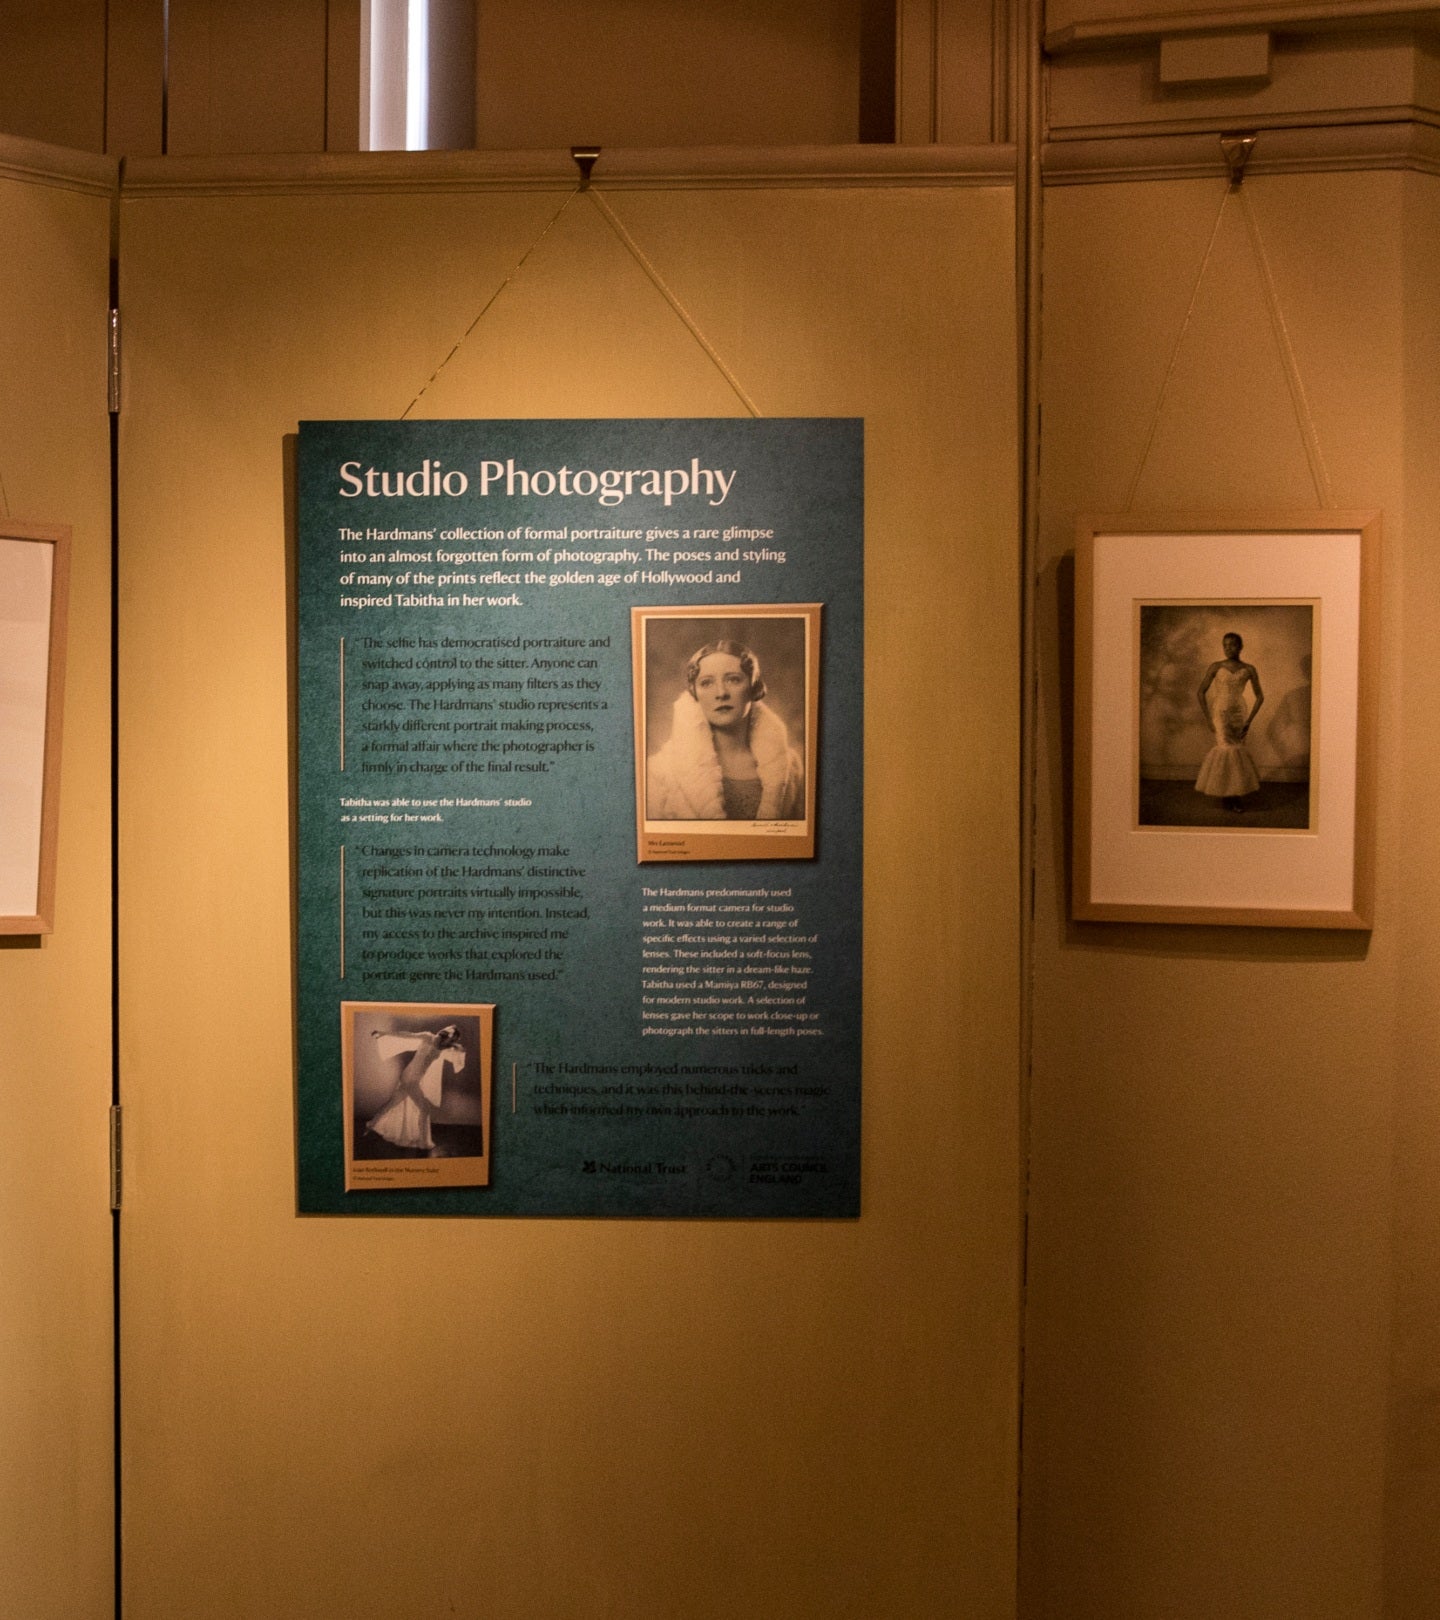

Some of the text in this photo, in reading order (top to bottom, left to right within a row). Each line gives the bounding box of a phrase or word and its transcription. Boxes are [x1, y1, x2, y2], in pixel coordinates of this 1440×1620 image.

[339, 458, 736, 506] Studio Photography
[338, 528, 363, 540] The
[440, 527, 504, 540] collection
[507, 527, 522, 539] of
[525, 527, 567, 539] formal
[571, 527, 642, 542] portraiture
[646, 527, 679, 541] gives
[682, 530, 690, 539] a
[694, 530, 719, 538] rare
[723, 526, 773, 541] glimpse
[341, 548, 786, 565] into an almost forgotten form of photography. The poses and styling
[340, 571, 740, 587] of many of the prints reflect the golden age of Hollywood and
[341, 594, 523, 609] inspired Tabitha in her work.
[387, 636, 415, 648] selfie
[419, 636, 438, 648] has
[441, 636, 520, 648] democratised
[523, 636, 585, 652] portraiture
[589, 636, 610, 648] and
[362, 657, 413, 669] switched
[416, 657, 457, 669] control
[460, 659, 473, 669] to
[475, 657, 494, 669] the
[531, 657, 575, 673] Anyone
[577, 661, 598, 669] can
[362, 681, 390, 694] snap
[425, 678, 475, 694] applying
[477, 681, 490, 690] as
[493, 681, 523, 694] many
[527, 678, 558, 690] filters
[561, 681, 574, 690] as
[577, 678, 601, 694] they
[409, 698, 430, 711] The
[499, 698, 535, 711] studio
[538, 700, 598, 715] represents
[601, 702, 608, 711] a
[362, 719, 400, 735] starkly
[402, 719, 450, 731] different
[453, 719, 497, 735] portrait
[501, 719, 544, 735] making
[362, 760, 394, 776] firmly
[395, 760, 407, 772] in
[409, 760, 448, 776] charge
[451, 760, 464, 772] of
[466, 760, 484, 772] the
[488, 760, 512, 772] final
[340, 798, 372, 806] Tabitha
[392, 798, 410, 806] able
[440, 798, 454, 806] the
[504, 798, 532, 806] studio
[359, 813, 388, 823] setting
[390, 813, 403, 821] for
[414, 844, 425, 857] in
[427, 848, 470, 857] camera
[472, 844, 535, 861] technology
[537, 844, 570, 857] make
[362, 865, 423, 881] replication
[426, 865, 439, 877] of
[441, 865, 459, 877] the
[527, 865, 586, 877] distinctive
[642, 888, 791, 898] The Hardmans predominantly used
[362, 906, 382, 918] but
[385, 906, 407, 918] this
[408, 910, 432, 918] was
[434, 910, 466, 918] never
[468, 910, 485, 922] my
[650, 903, 685, 911] medium
[687, 903, 716, 912] format
[767, 904, 794, 912] studio
[643, 934, 674, 944] specific
[677, 934, 705, 942] effects
[707, 935, 731, 944] using
[768, 935, 806, 943] selection
[808, 934, 817, 942] of
[642, 980, 674, 988] Tabitha
[676, 980, 696, 989] used
[705, 980, 739, 990] Mamiya
[768, 981, 807, 991] designed
[642, 1026, 693, 1036] photograph
[695, 1026, 709, 1035] the
[712, 1026, 738, 1035] sitters
[751, 1026, 795, 1037] full-length
